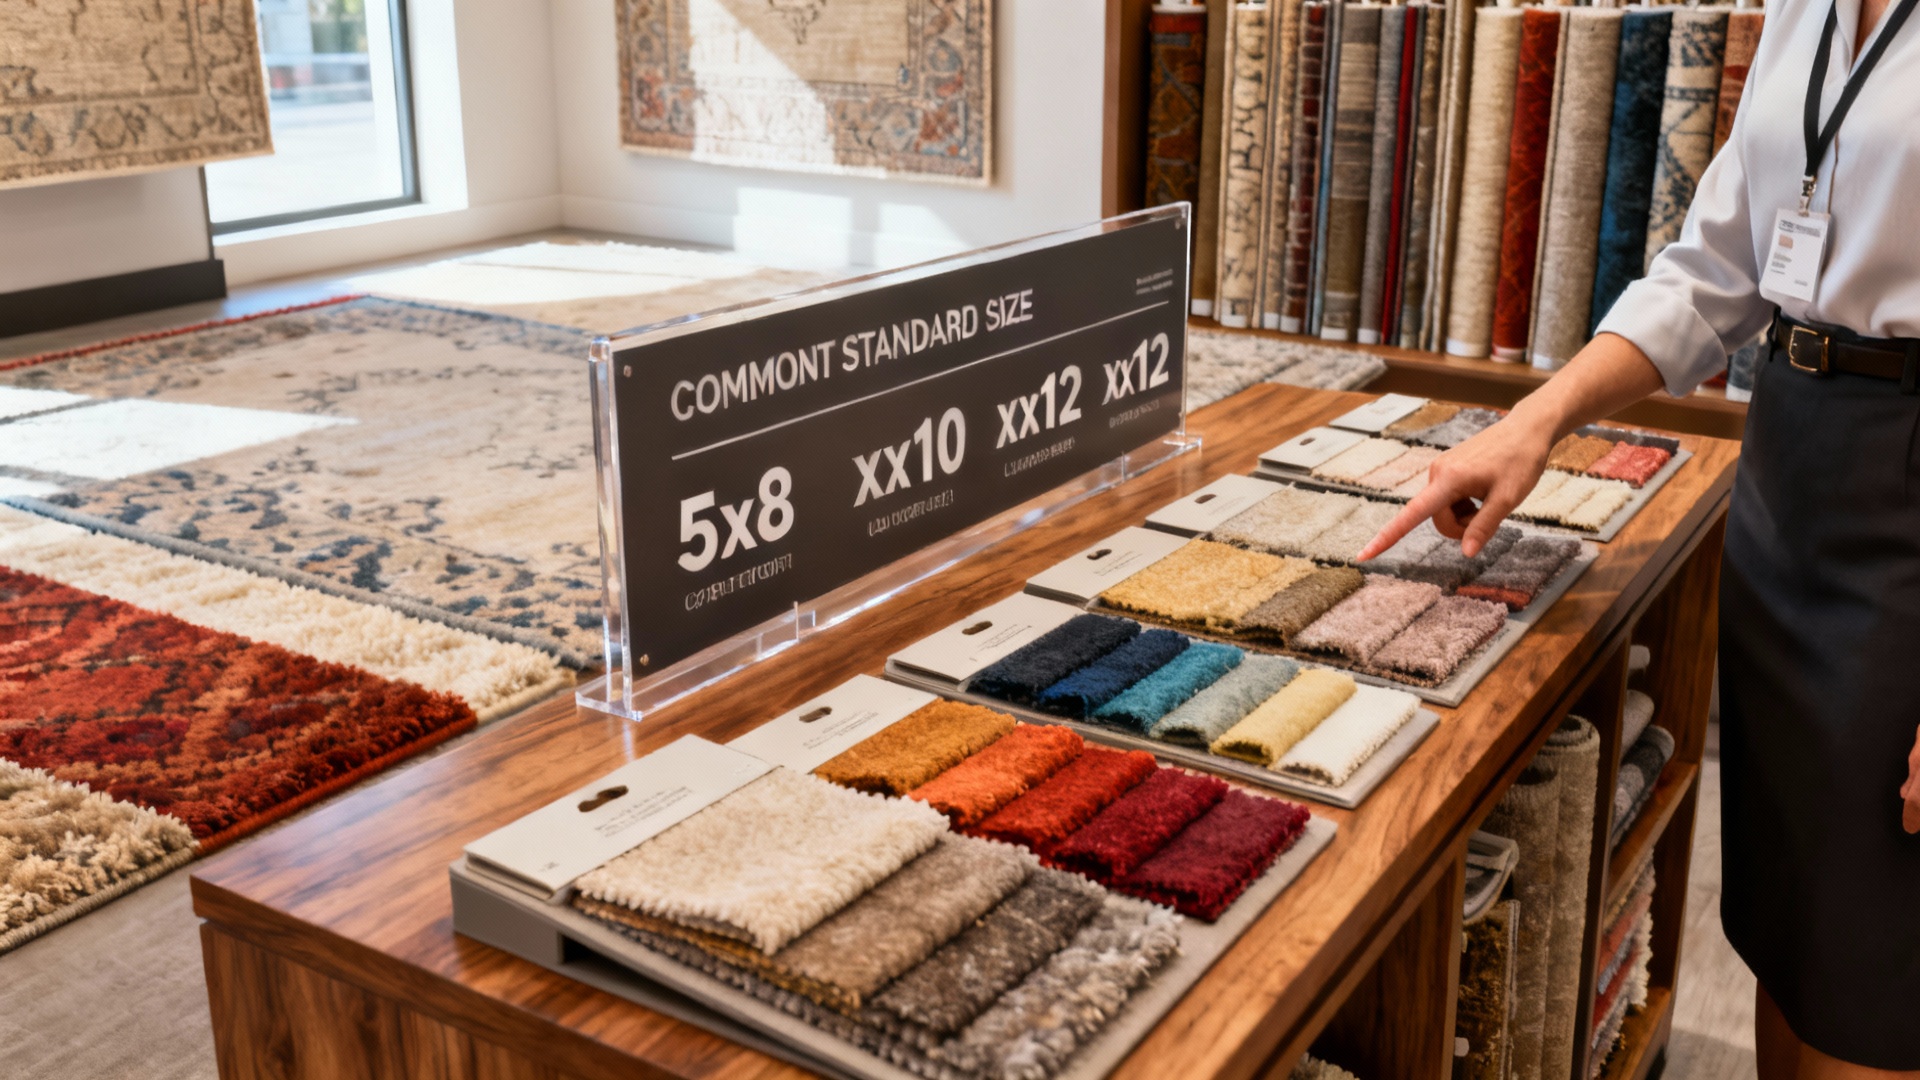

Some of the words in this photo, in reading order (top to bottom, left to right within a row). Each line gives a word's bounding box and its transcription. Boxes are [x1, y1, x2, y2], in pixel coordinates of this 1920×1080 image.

[671, 340, 836, 421] COMMONT
[842, 305, 978, 371] STANDARD
[985, 289, 1033, 332] SIZE
[678, 466, 794, 572] 5x8
